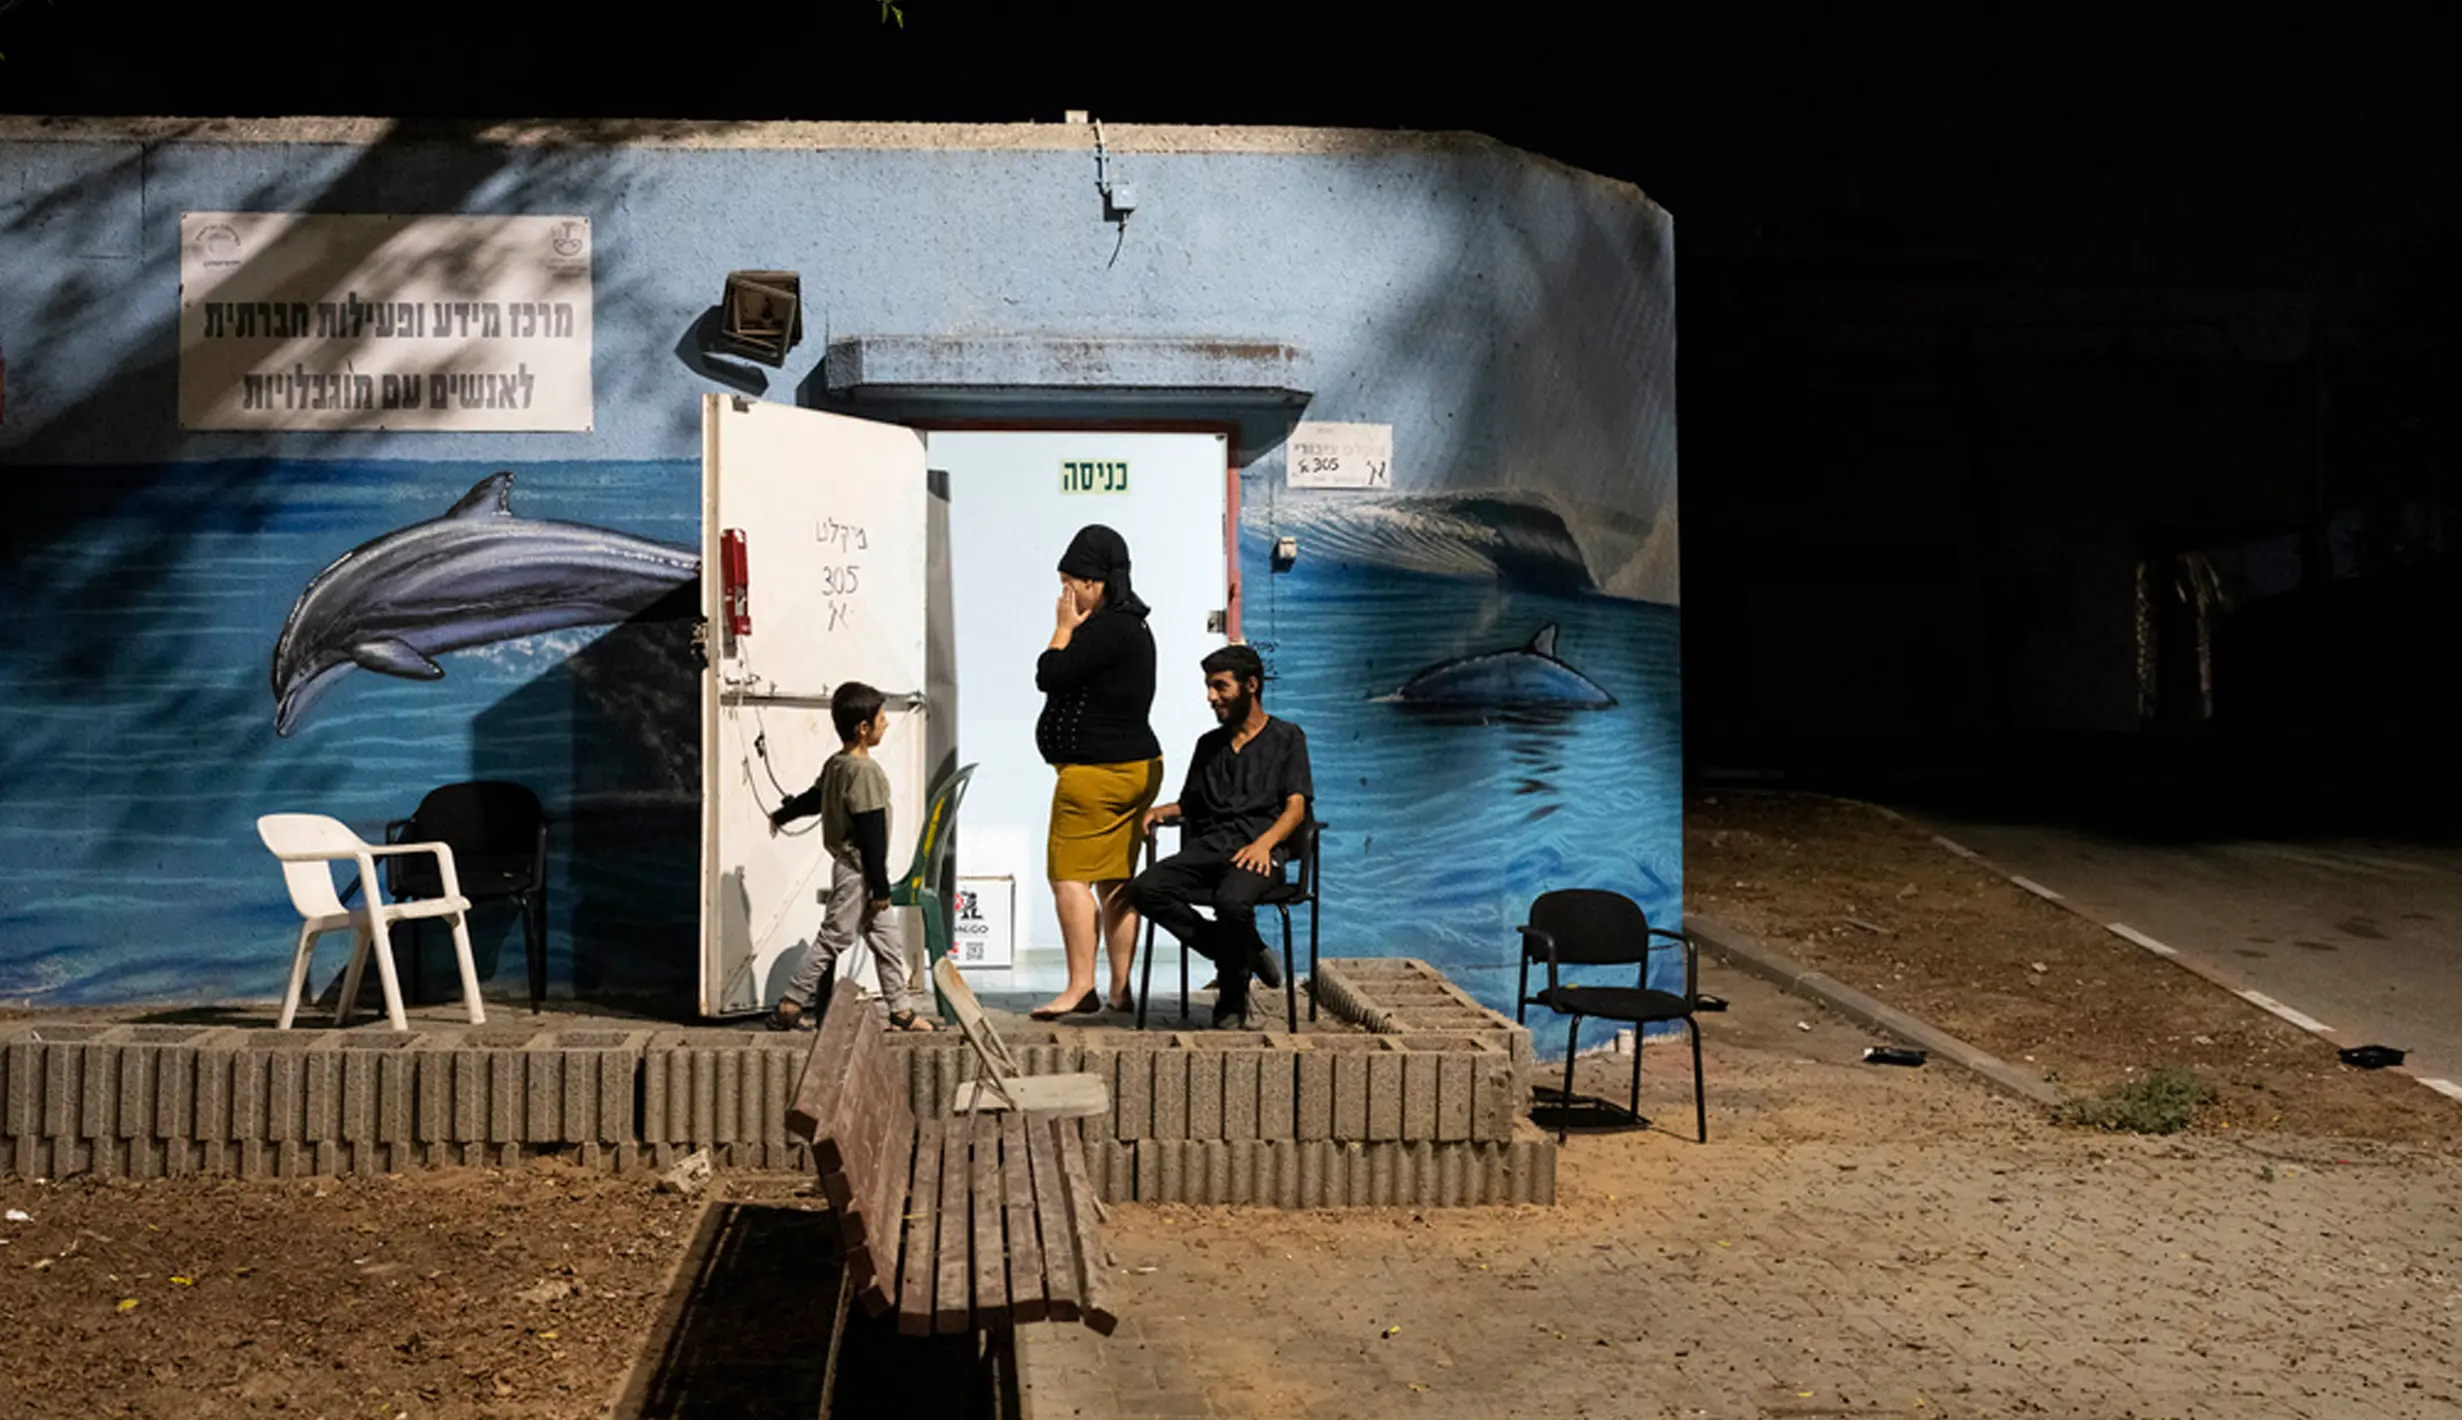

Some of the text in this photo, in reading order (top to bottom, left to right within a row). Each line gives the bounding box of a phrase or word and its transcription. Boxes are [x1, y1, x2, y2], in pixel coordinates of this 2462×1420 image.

[204, 291, 574, 338] מרכז מידע ופעילות חברתית
[381, 373, 422, 410] עם
[430, 363, 535, 410] לאנשים
[1063, 461, 1128, 491] כניסה
[1312, 457, 1340, 473] 305
[816, 516, 868, 554] מקלט
[821, 565, 860, 597] 305
